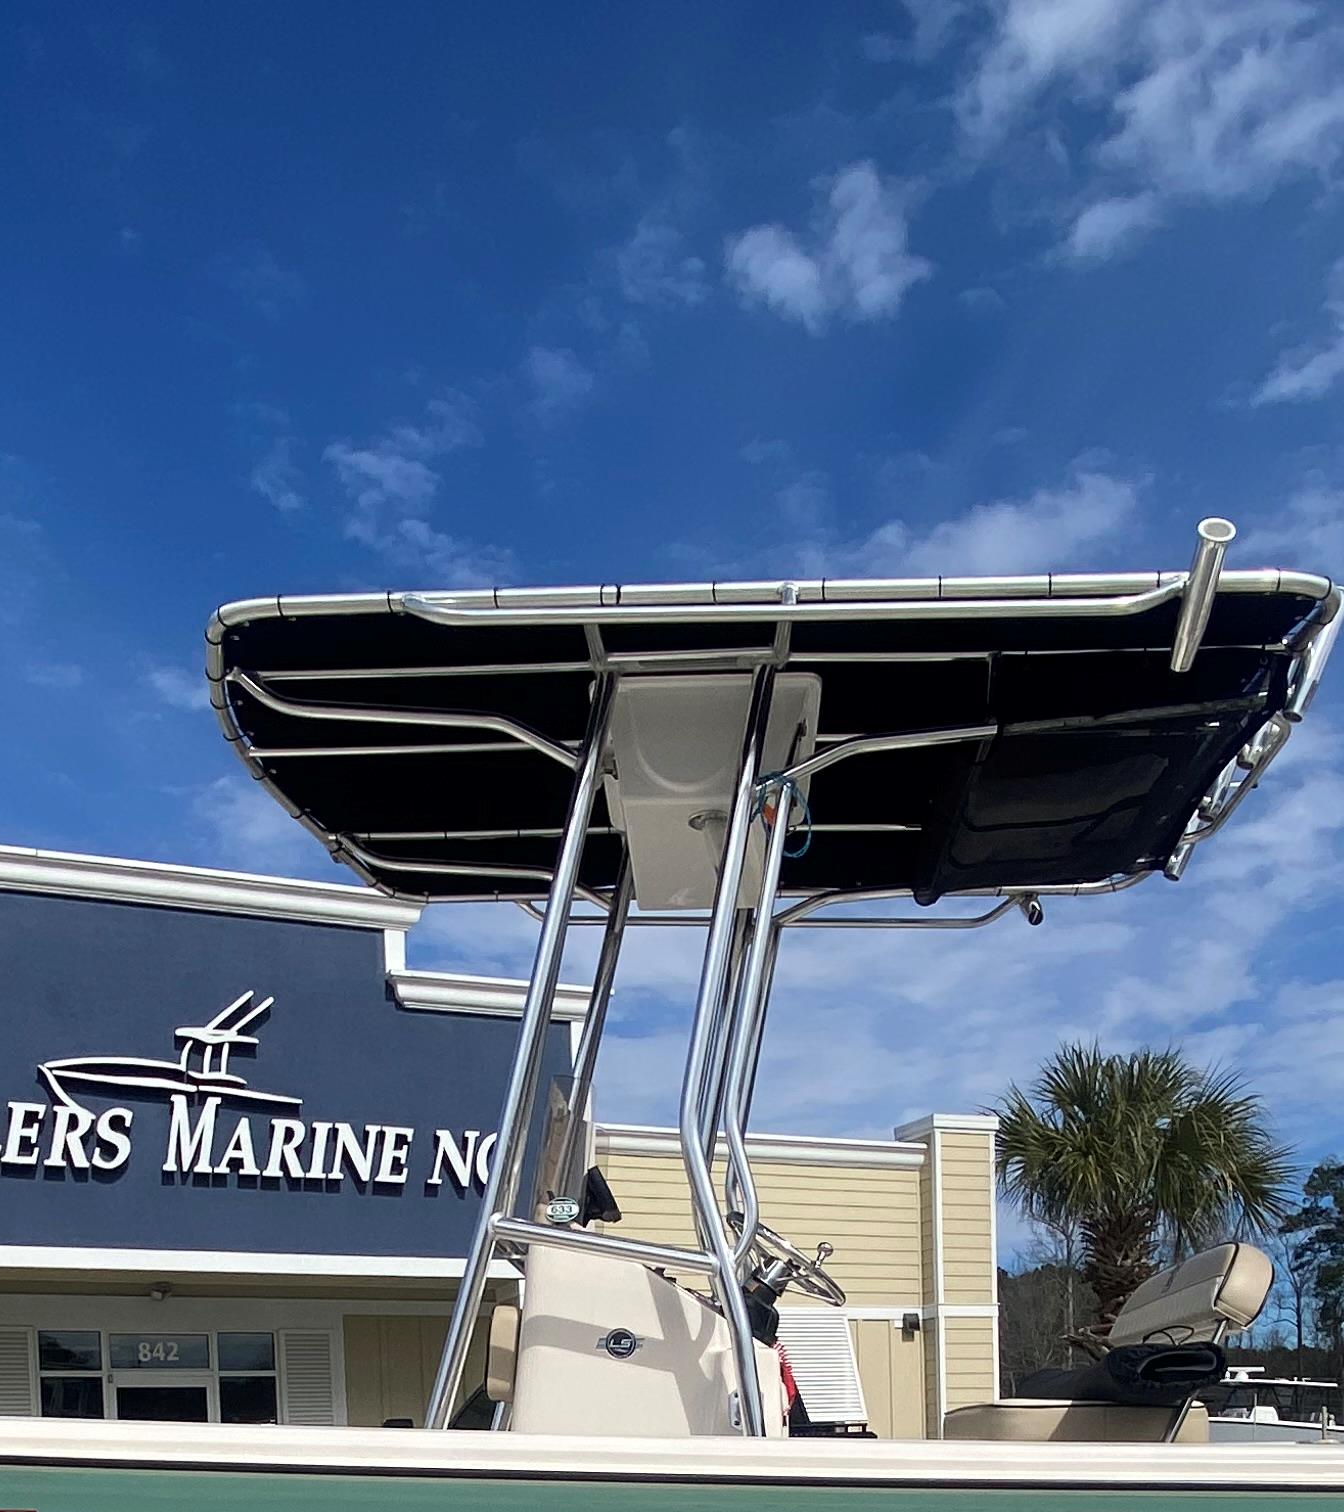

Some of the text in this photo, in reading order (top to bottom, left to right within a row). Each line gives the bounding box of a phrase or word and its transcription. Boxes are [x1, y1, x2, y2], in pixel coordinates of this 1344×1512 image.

[162, 1094, 414, 1184] MARINE
[551, 1205, 573, 1214] 633
[137, 1341, 179, 1362] 842
